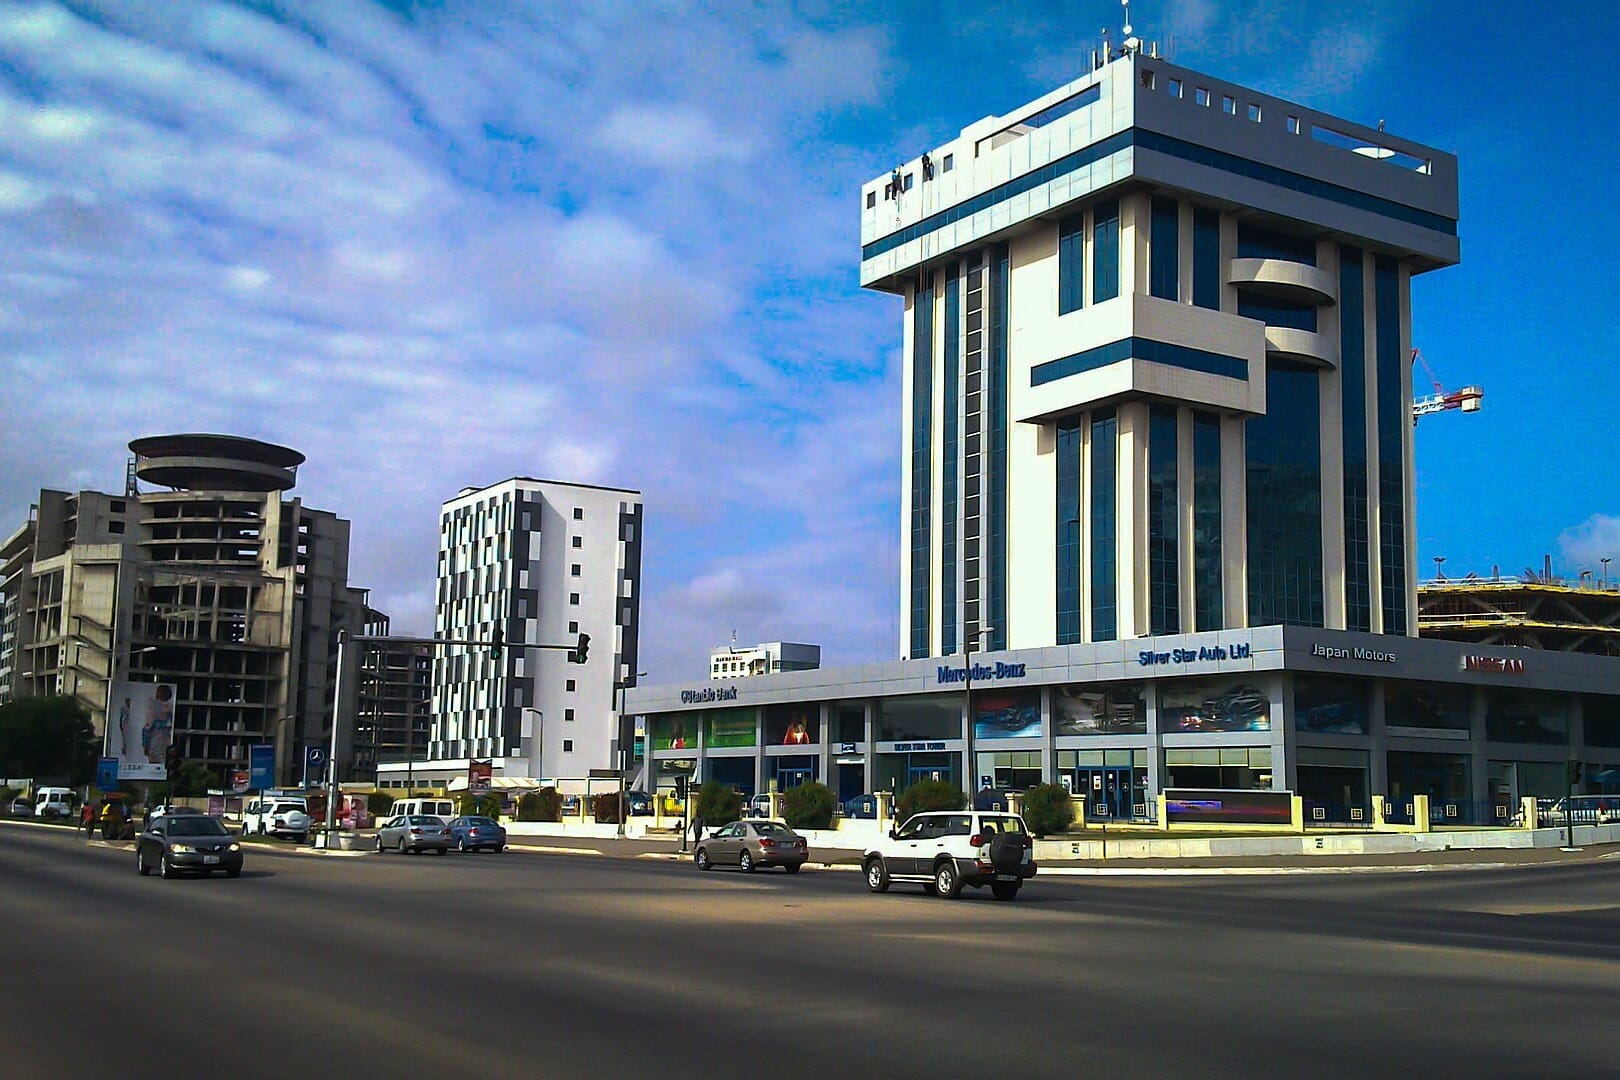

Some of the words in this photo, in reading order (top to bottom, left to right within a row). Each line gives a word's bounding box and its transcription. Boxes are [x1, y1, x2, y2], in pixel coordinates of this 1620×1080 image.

[1138, 650, 1171, 666] Silver
[1172, 648, 1197, 664] Star
[1199, 645, 1226, 661] Auto
[1312, 643, 1350, 659] Japan
[1353, 647, 1396, 662] Motors
